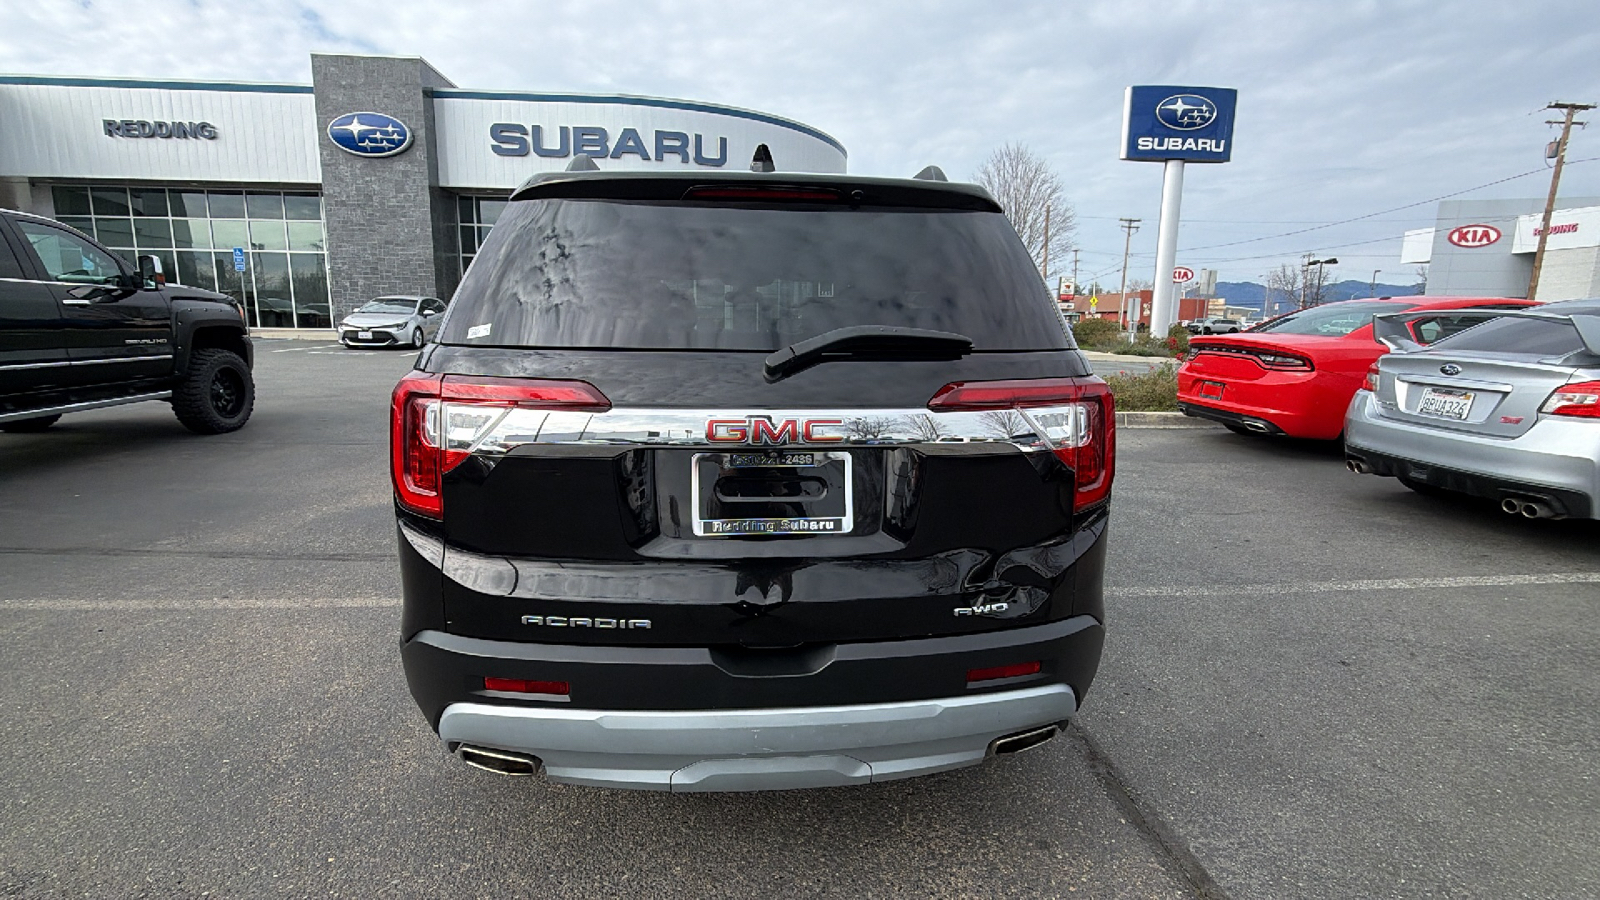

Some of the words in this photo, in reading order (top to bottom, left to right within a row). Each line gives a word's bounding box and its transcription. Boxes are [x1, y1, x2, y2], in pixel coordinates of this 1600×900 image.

[102, 119, 217, 140] REDDING
[489, 123, 727, 167] SUBARU
[1137, 137, 1225, 153] SUBARU
[1457, 229, 1492, 243] KIA
[1533, 223, 1579, 236] RDDING
[705, 417, 845, 445] GMC
[712, 521, 776, 533] Redding
[780, 519, 834, 530] Subaru
[953, 603, 1008, 616] AWD
[521, 615, 652, 629] ACADIA
